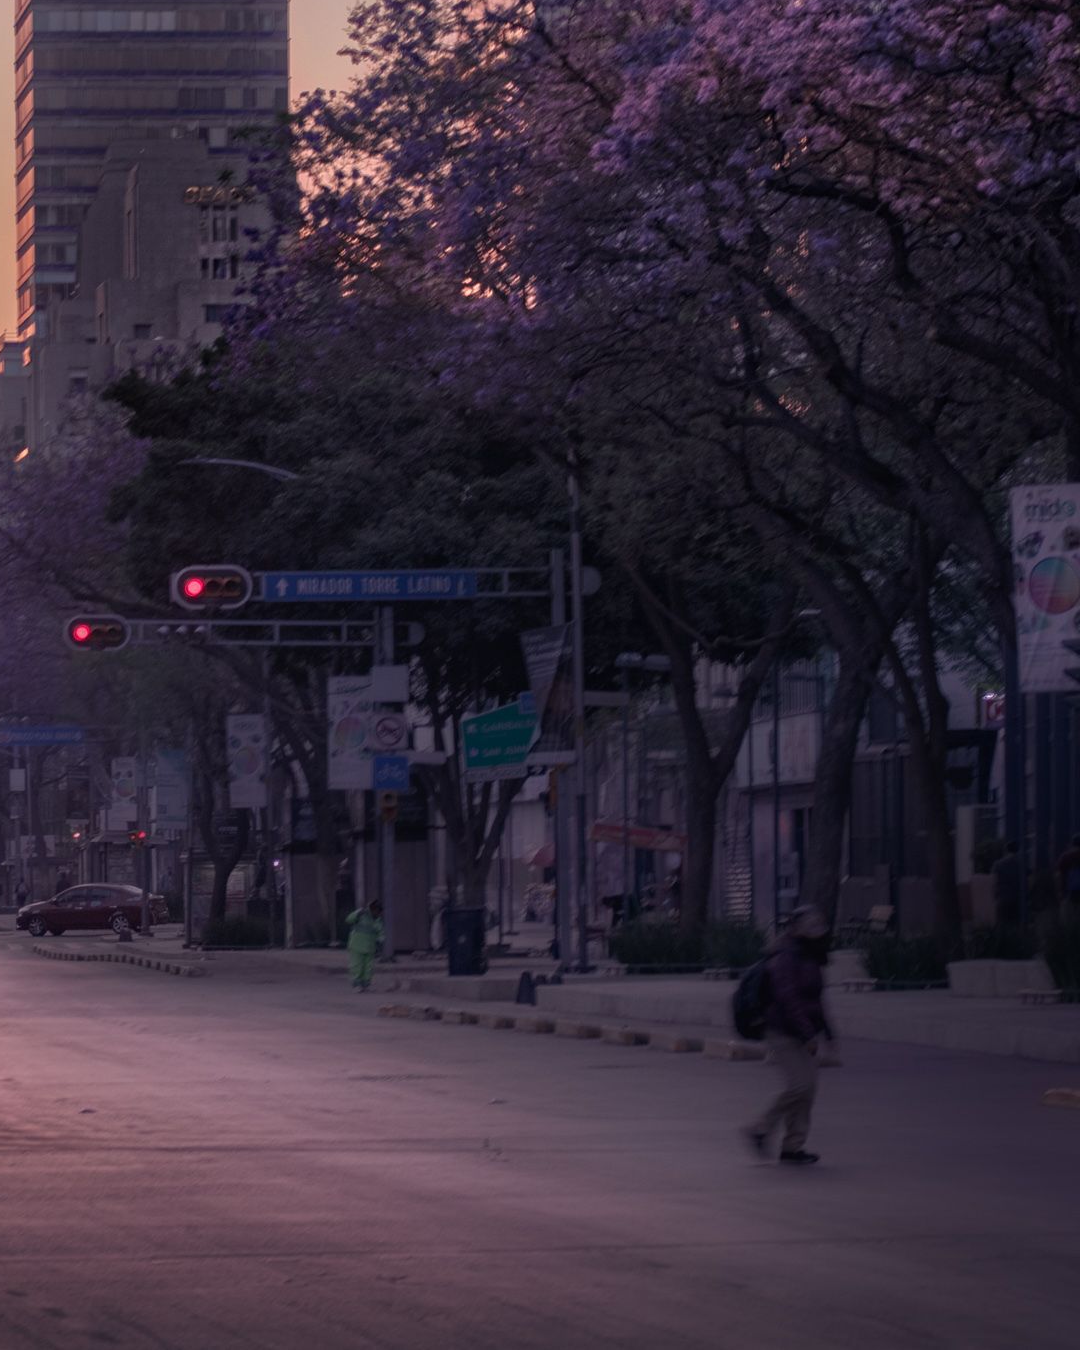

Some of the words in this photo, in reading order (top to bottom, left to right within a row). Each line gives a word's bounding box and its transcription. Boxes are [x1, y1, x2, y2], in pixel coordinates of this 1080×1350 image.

[296, 578, 353, 595] MIRADOR
[360, 577, 400, 594] TORRE
[407, 577, 451, 593] LATINO
